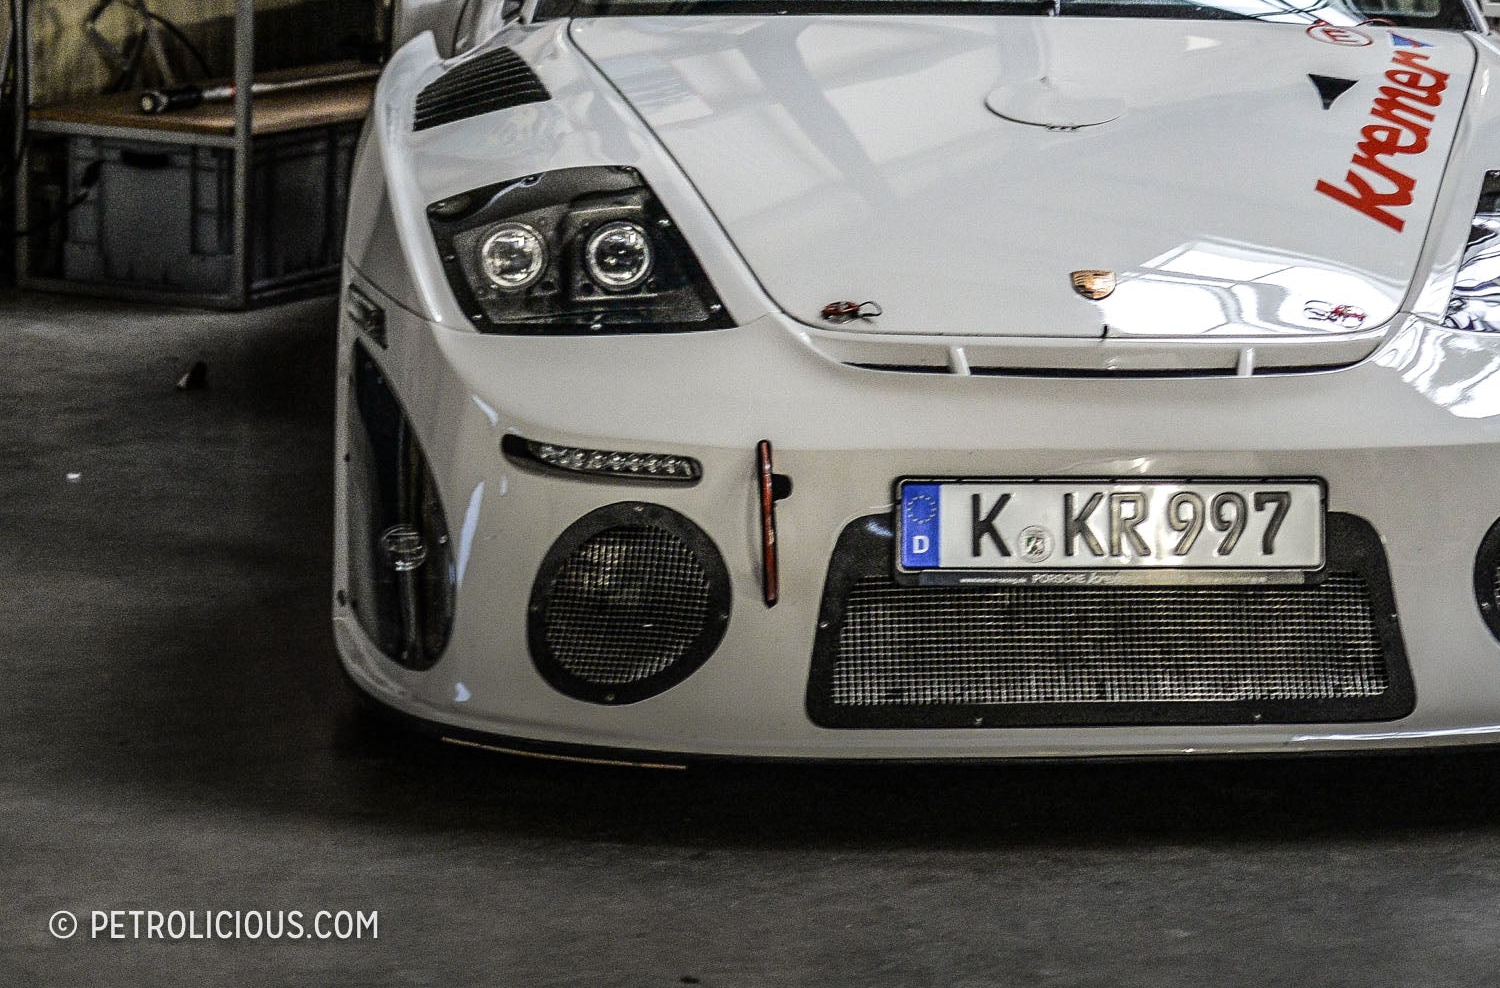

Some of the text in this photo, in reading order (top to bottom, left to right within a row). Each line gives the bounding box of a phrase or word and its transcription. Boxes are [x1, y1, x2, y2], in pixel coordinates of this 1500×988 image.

[1314, 49, 1452, 234] kremer
[912, 535, 930, 554] D
[970, 491, 1292, 558] K KR 997
[1031, 572, 1087, 585] PORSCHE
